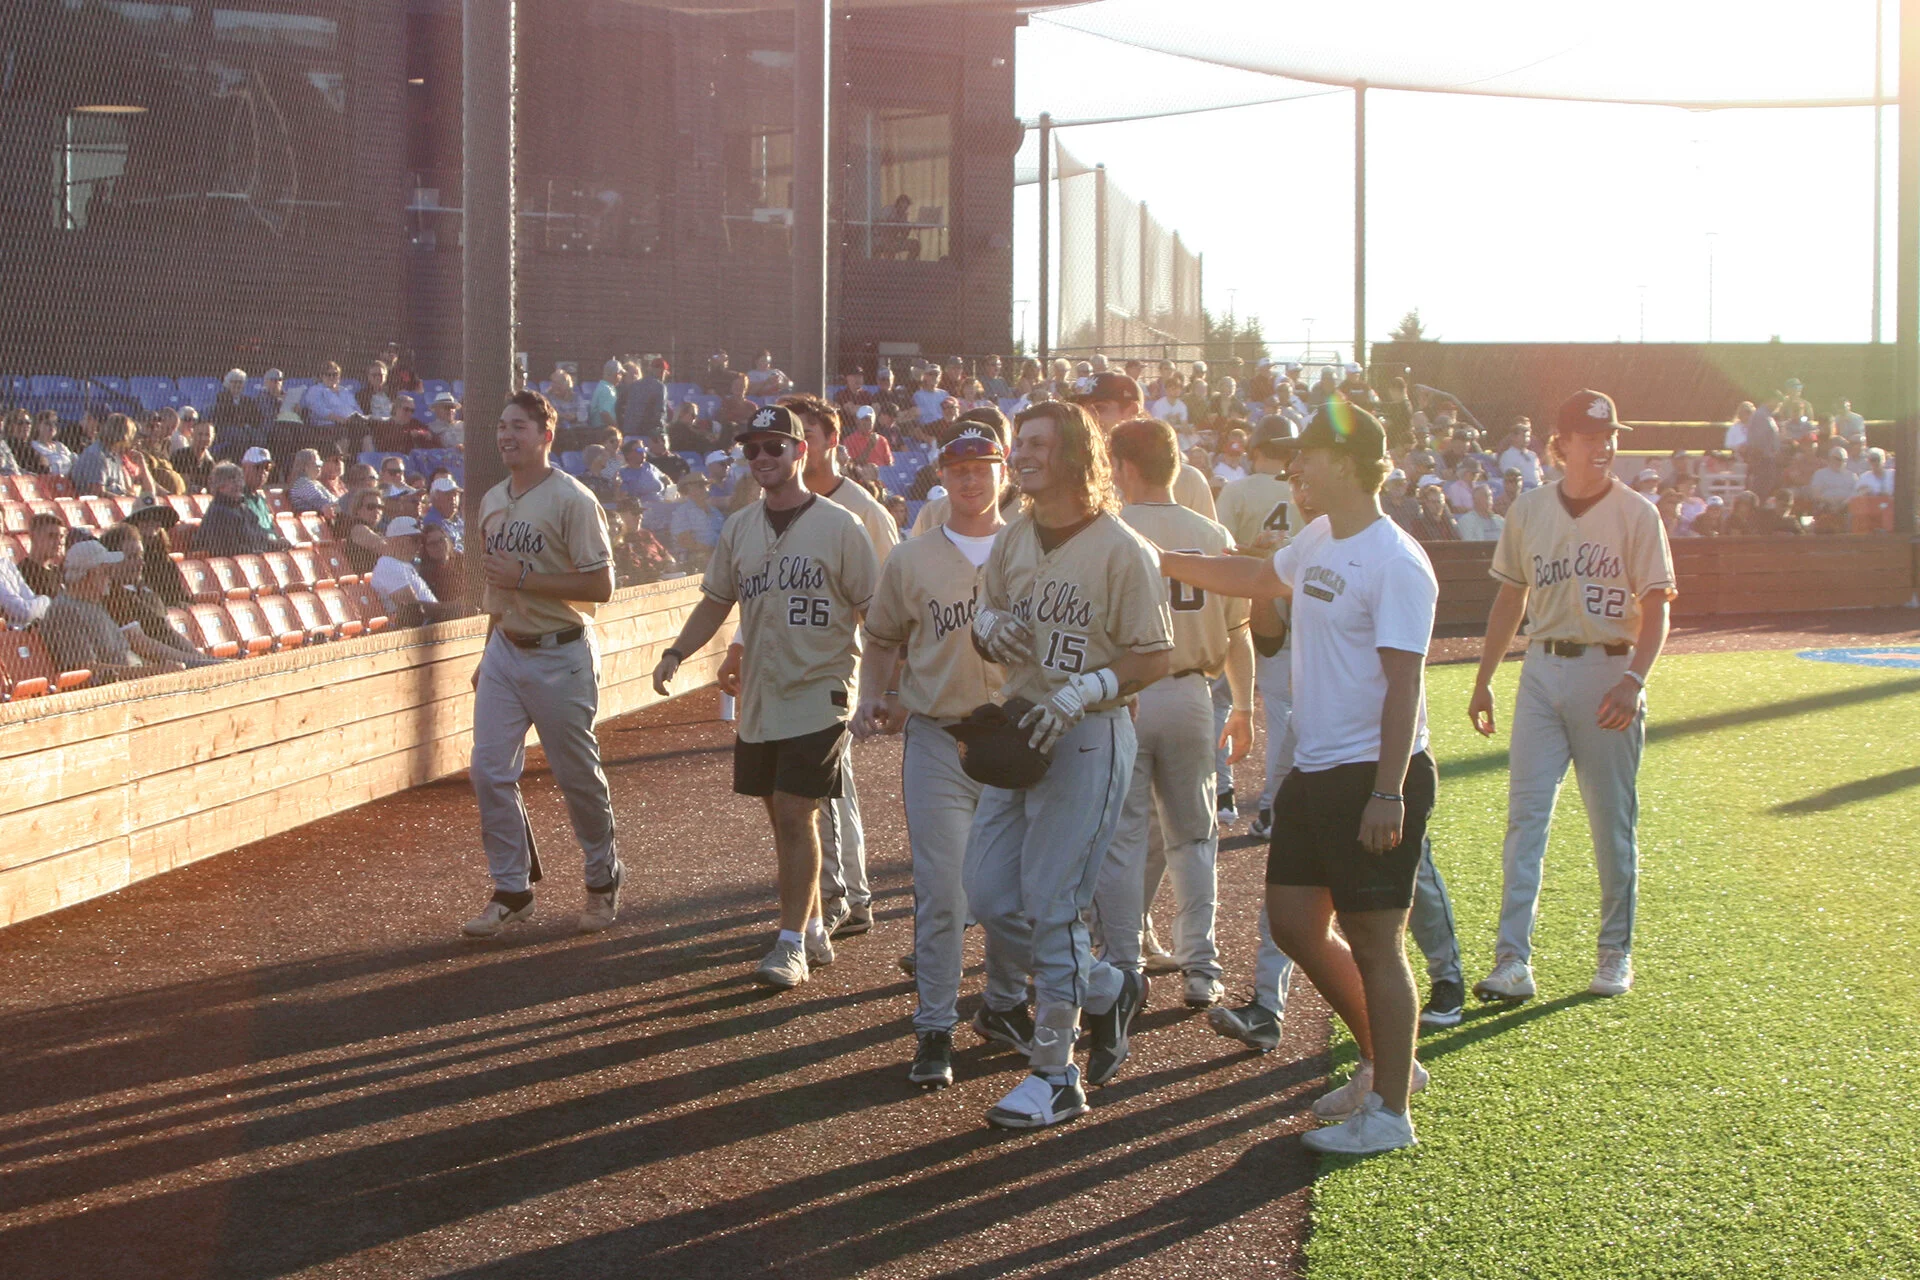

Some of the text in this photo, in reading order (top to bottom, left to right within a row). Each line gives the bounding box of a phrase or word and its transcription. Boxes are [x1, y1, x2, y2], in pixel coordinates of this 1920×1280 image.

[506, 521, 545, 554] Elks
[779, 556, 824, 590] Elks
[1574, 543, 1623, 578] Elks
[789, 596, 829, 627] 26
[1037, 580, 1093, 627] Elks
[1585, 585, 1626, 618] 22
[1043, 630, 1086, 673] 15
